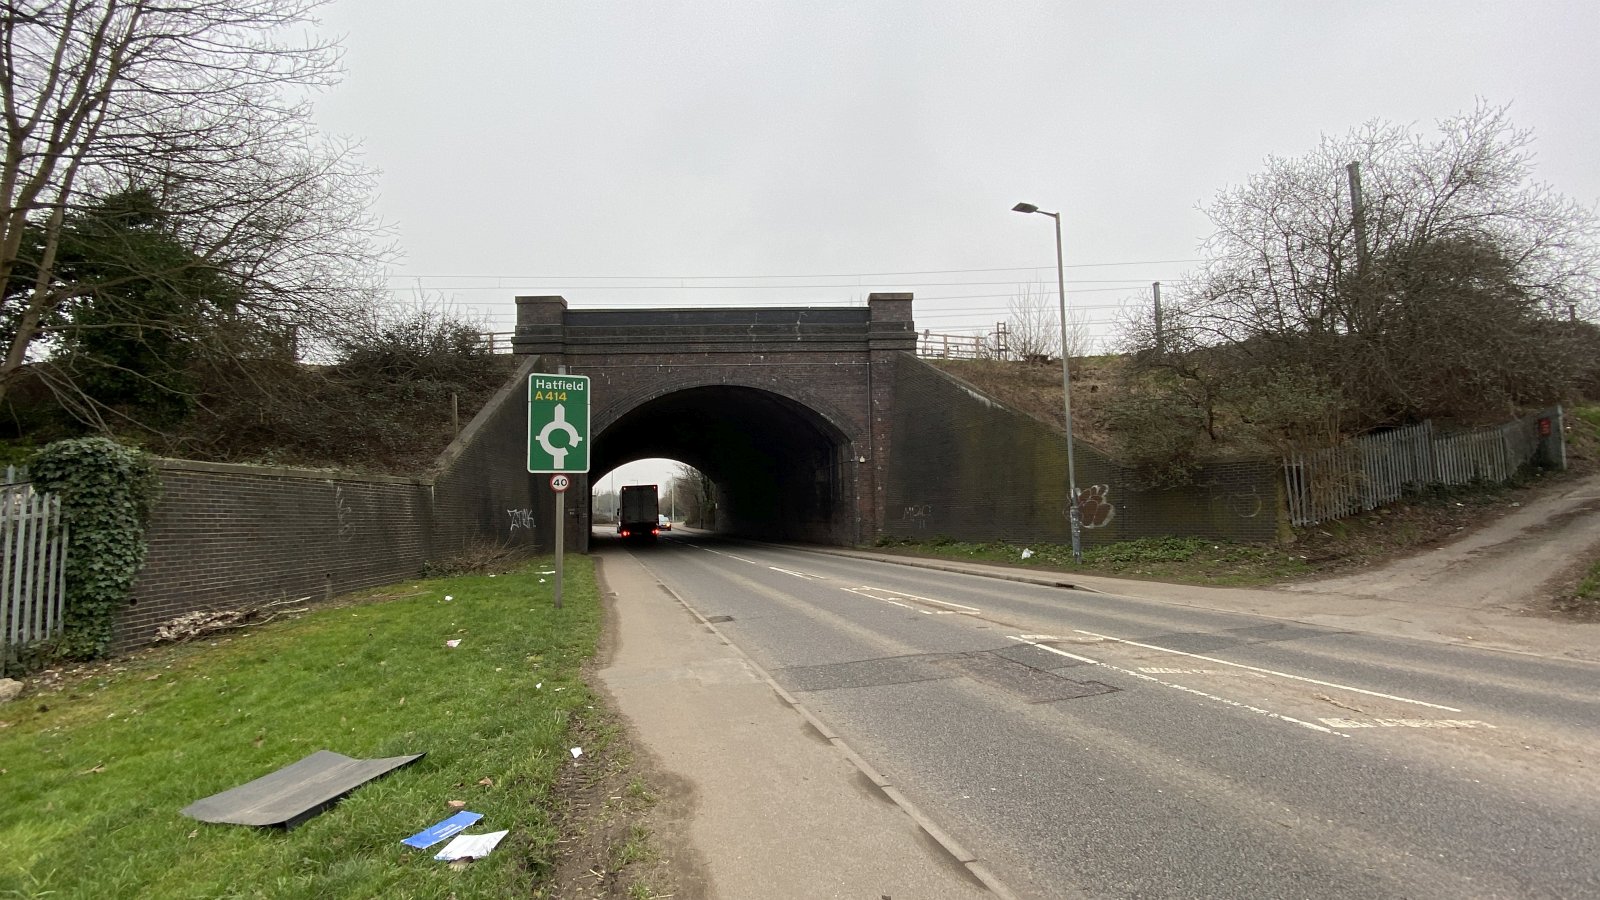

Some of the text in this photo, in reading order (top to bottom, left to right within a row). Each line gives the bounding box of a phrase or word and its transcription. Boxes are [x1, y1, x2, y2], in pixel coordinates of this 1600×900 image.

[536, 379, 584, 391] Hatfield
[535, 391, 567, 401] A414
[553, 478, 568, 487] 40
